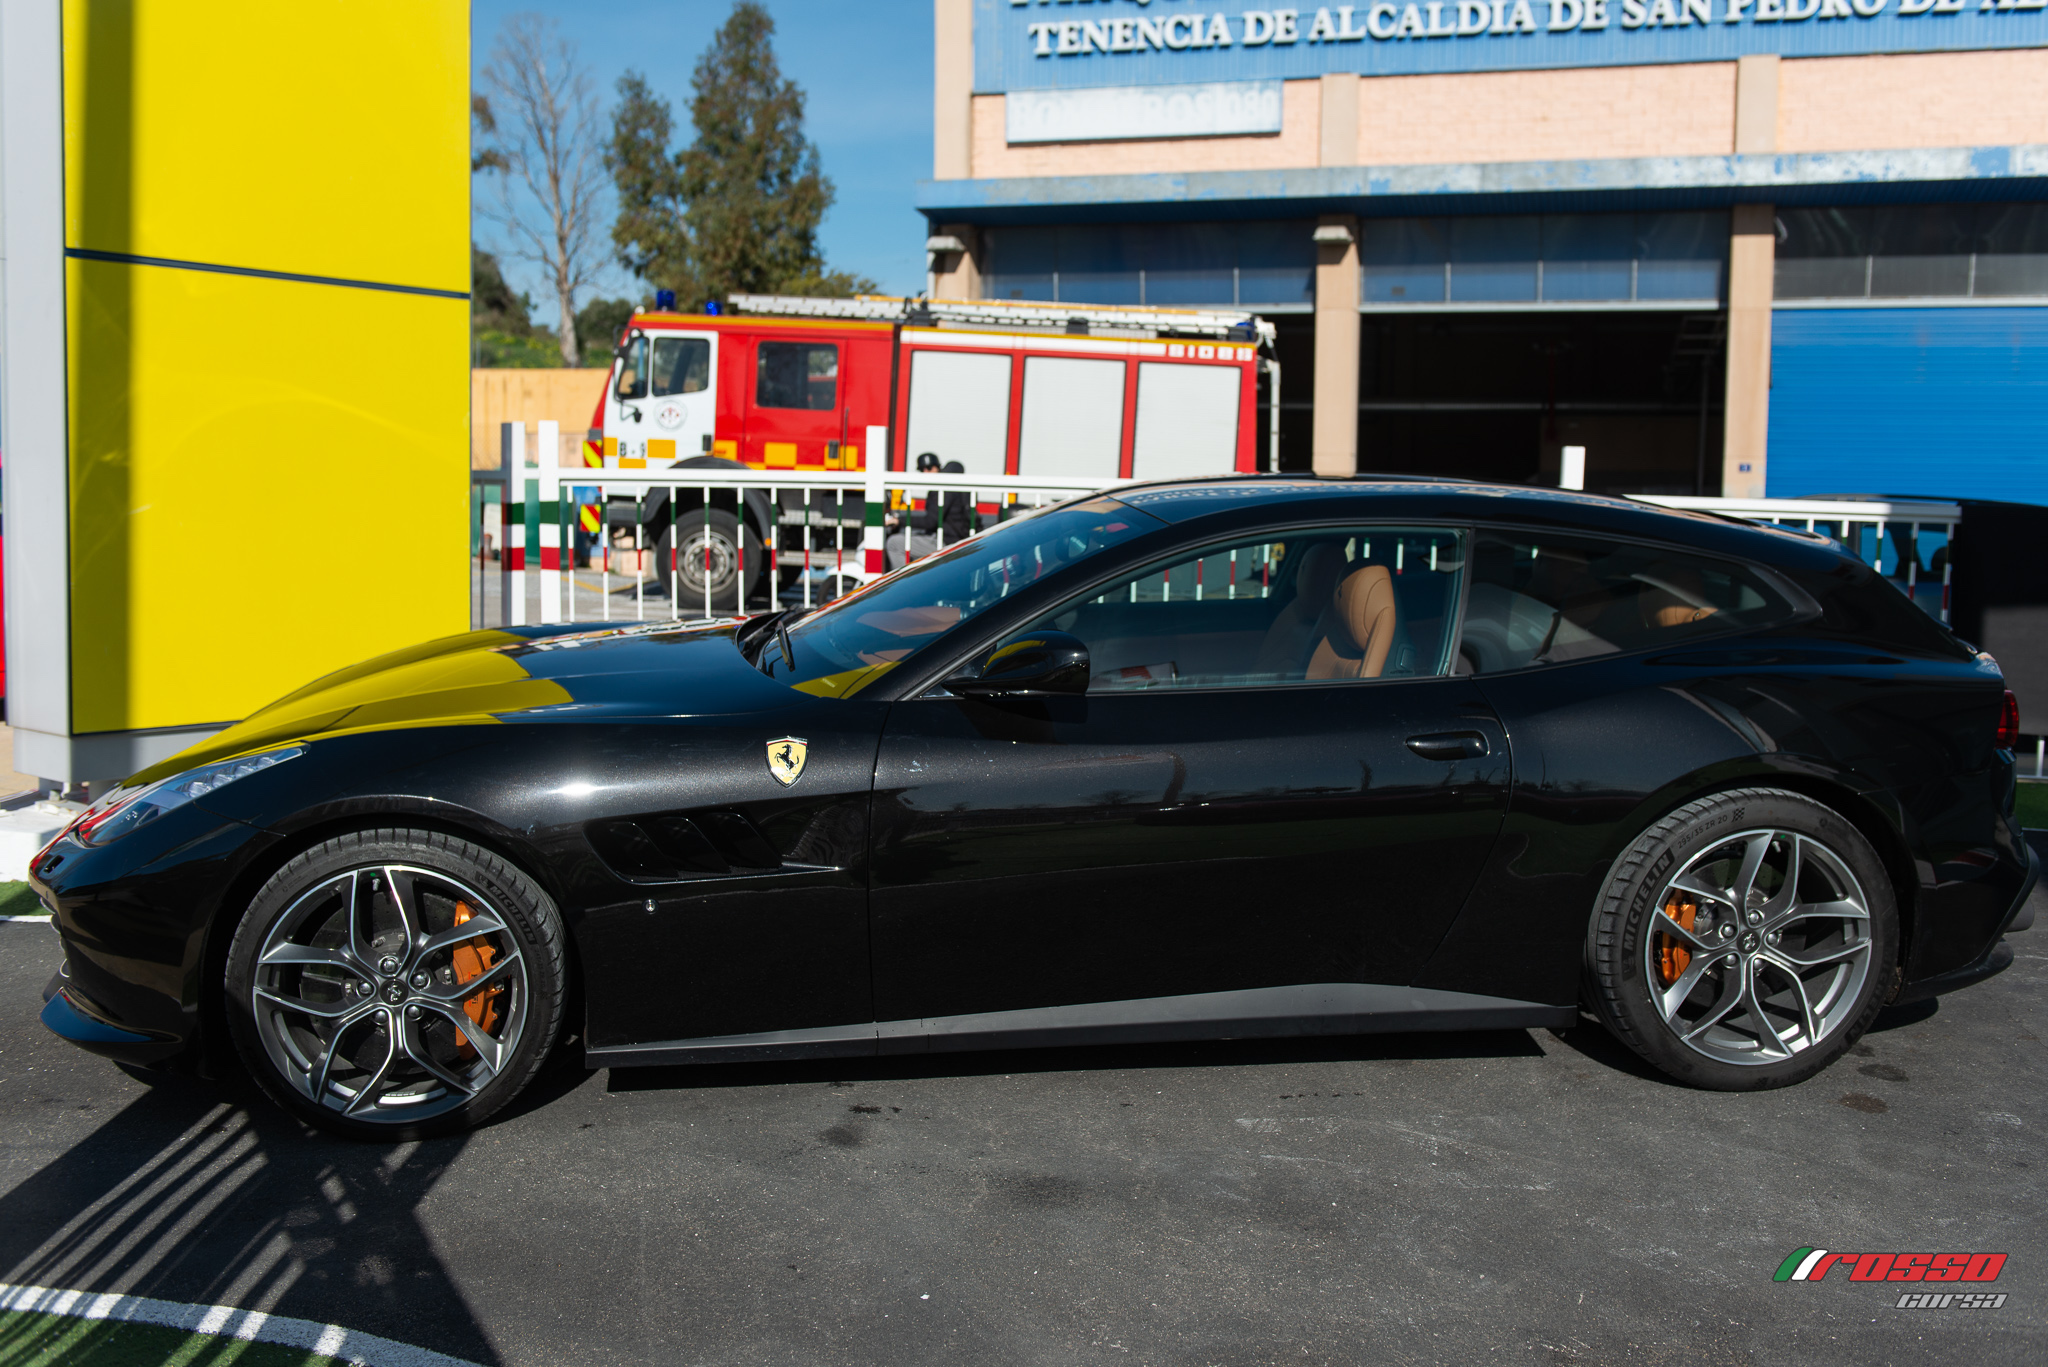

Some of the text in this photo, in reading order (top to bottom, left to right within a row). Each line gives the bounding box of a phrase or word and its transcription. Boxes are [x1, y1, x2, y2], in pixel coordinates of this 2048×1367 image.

[1028, 12, 1233, 57] TENENCIA
[1243, 9, 1299, 45] DE
[1308, 0, 1537, 42] ALCALDIA
[1548, 0, 1609, 33] DE
[1621, 0, 1712, 28] SAN
[1677, 814, 1729, 849] 295/35 ZR 20
[490, 885, 536, 944] MICHELIN
[1623, 853, 1674, 948] MICHELIN
